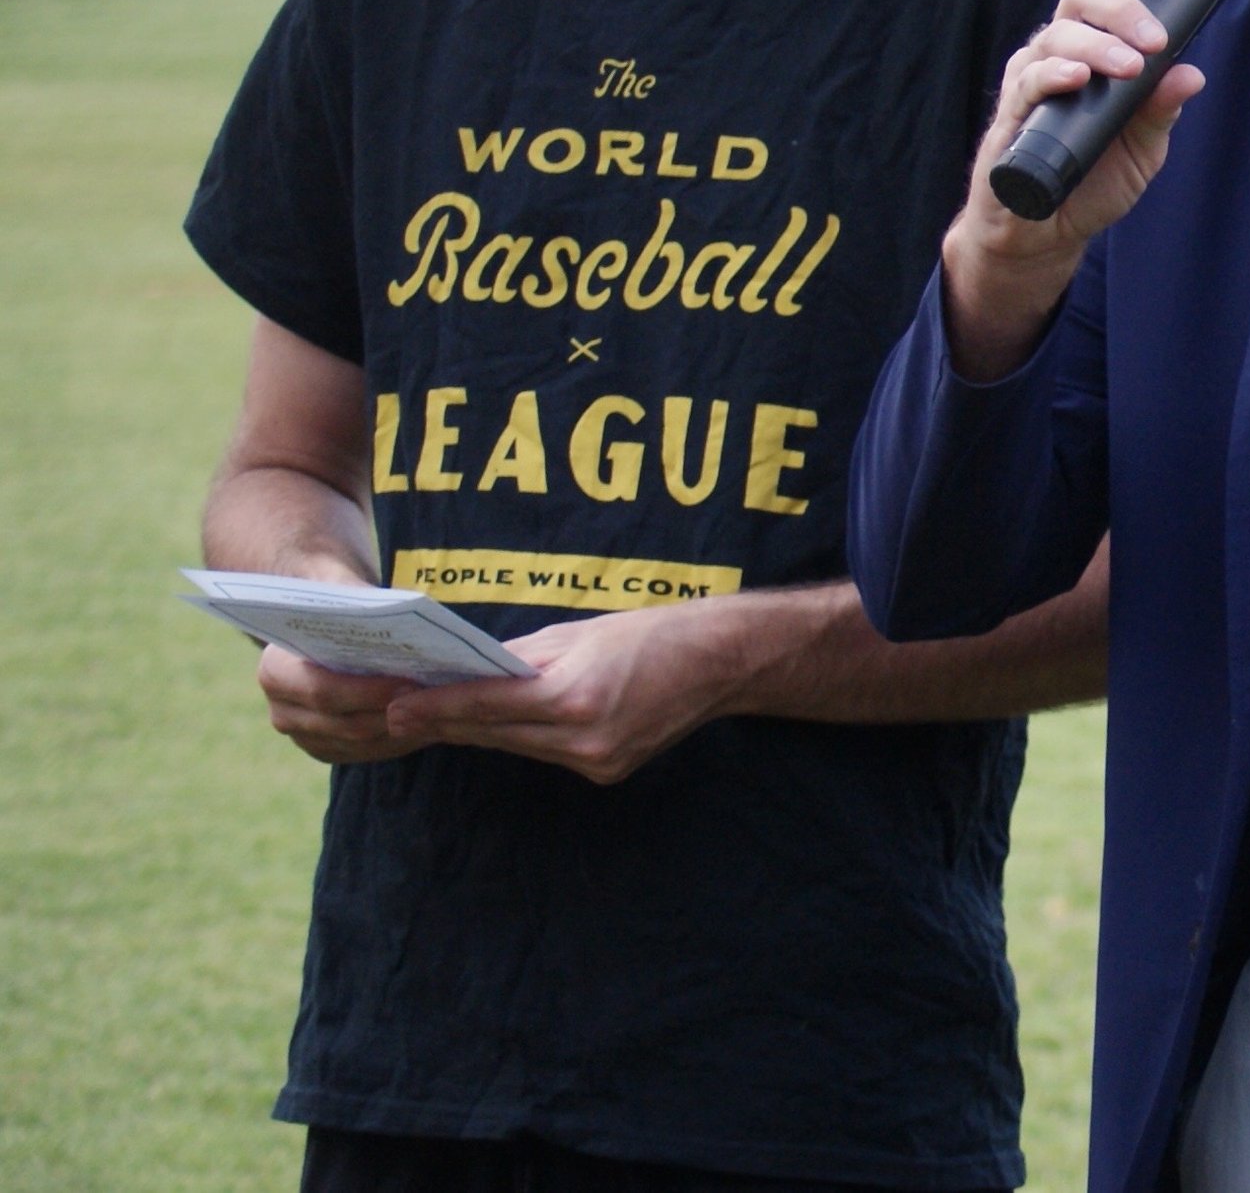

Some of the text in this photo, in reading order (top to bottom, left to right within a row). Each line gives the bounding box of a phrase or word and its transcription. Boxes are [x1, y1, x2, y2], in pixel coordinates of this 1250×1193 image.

[594, 58, 656, 99] The
[458, 127, 769, 181] WORLD
[387, 191, 840, 317] Baseball
[372, 386, 818, 515] LEAGUE
[415, 568, 513, 585] PEOPLE
[528, 571, 610, 592] WILL
